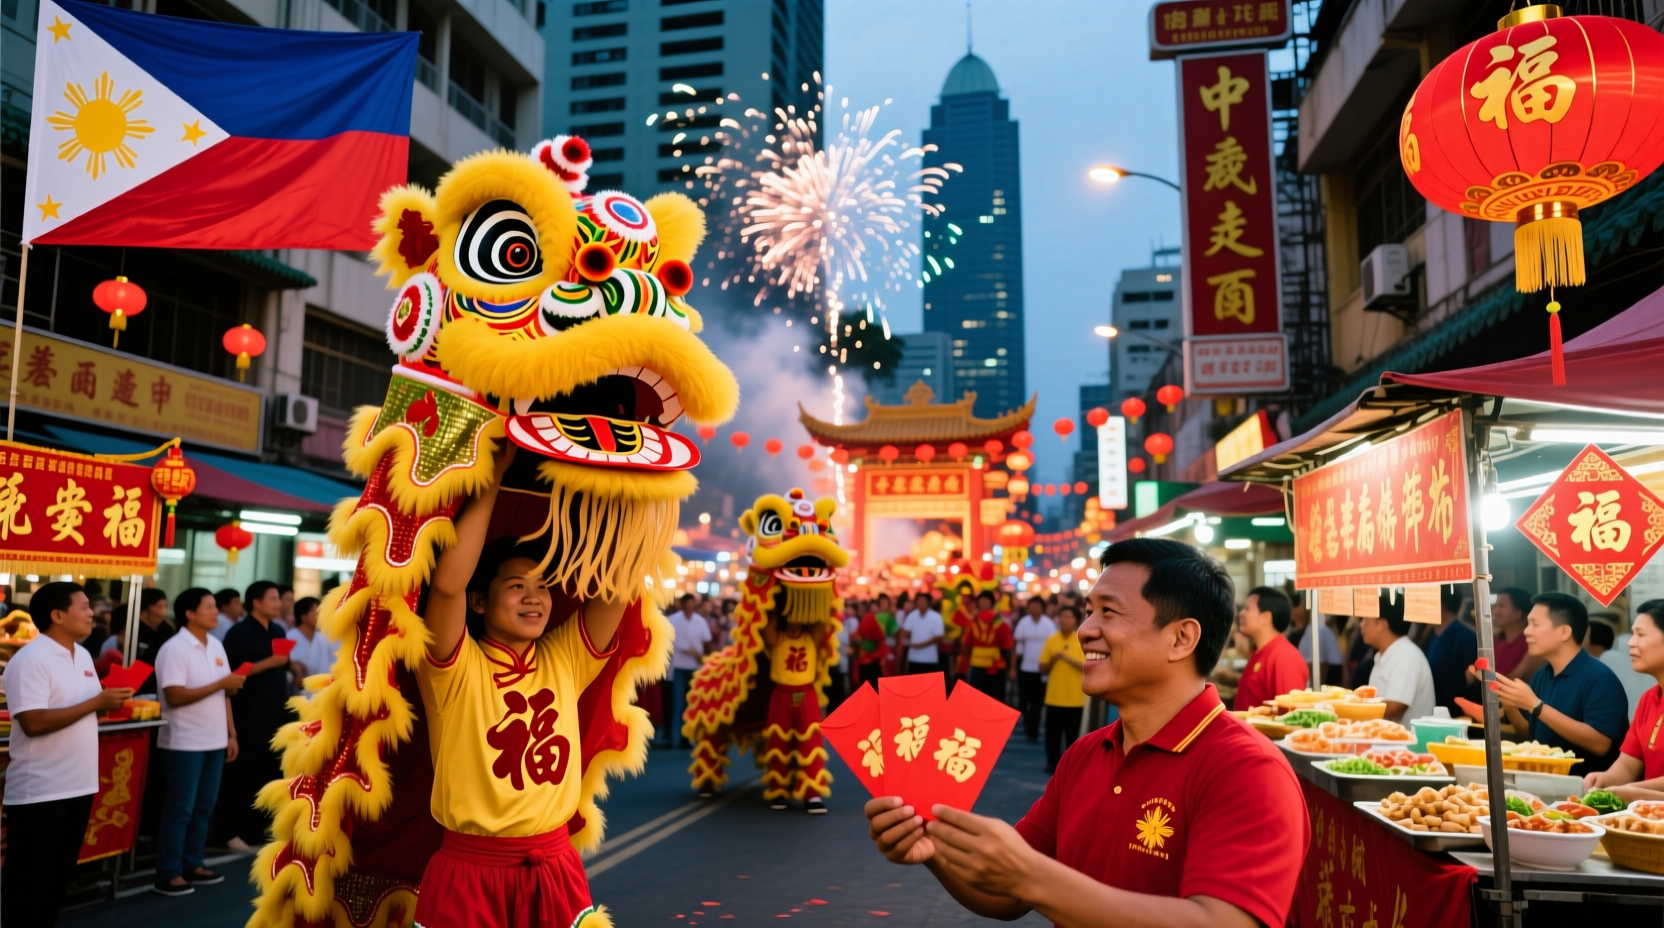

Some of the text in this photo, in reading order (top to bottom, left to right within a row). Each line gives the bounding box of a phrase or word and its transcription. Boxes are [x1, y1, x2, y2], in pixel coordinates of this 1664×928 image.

[1470, 35, 1577, 130] 福
[1567, 489, 1632, 552] 福
[784, 646, 808, 673] 福
[486, 688, 571, 791] 福
[933, 727, 982, 783] 福
